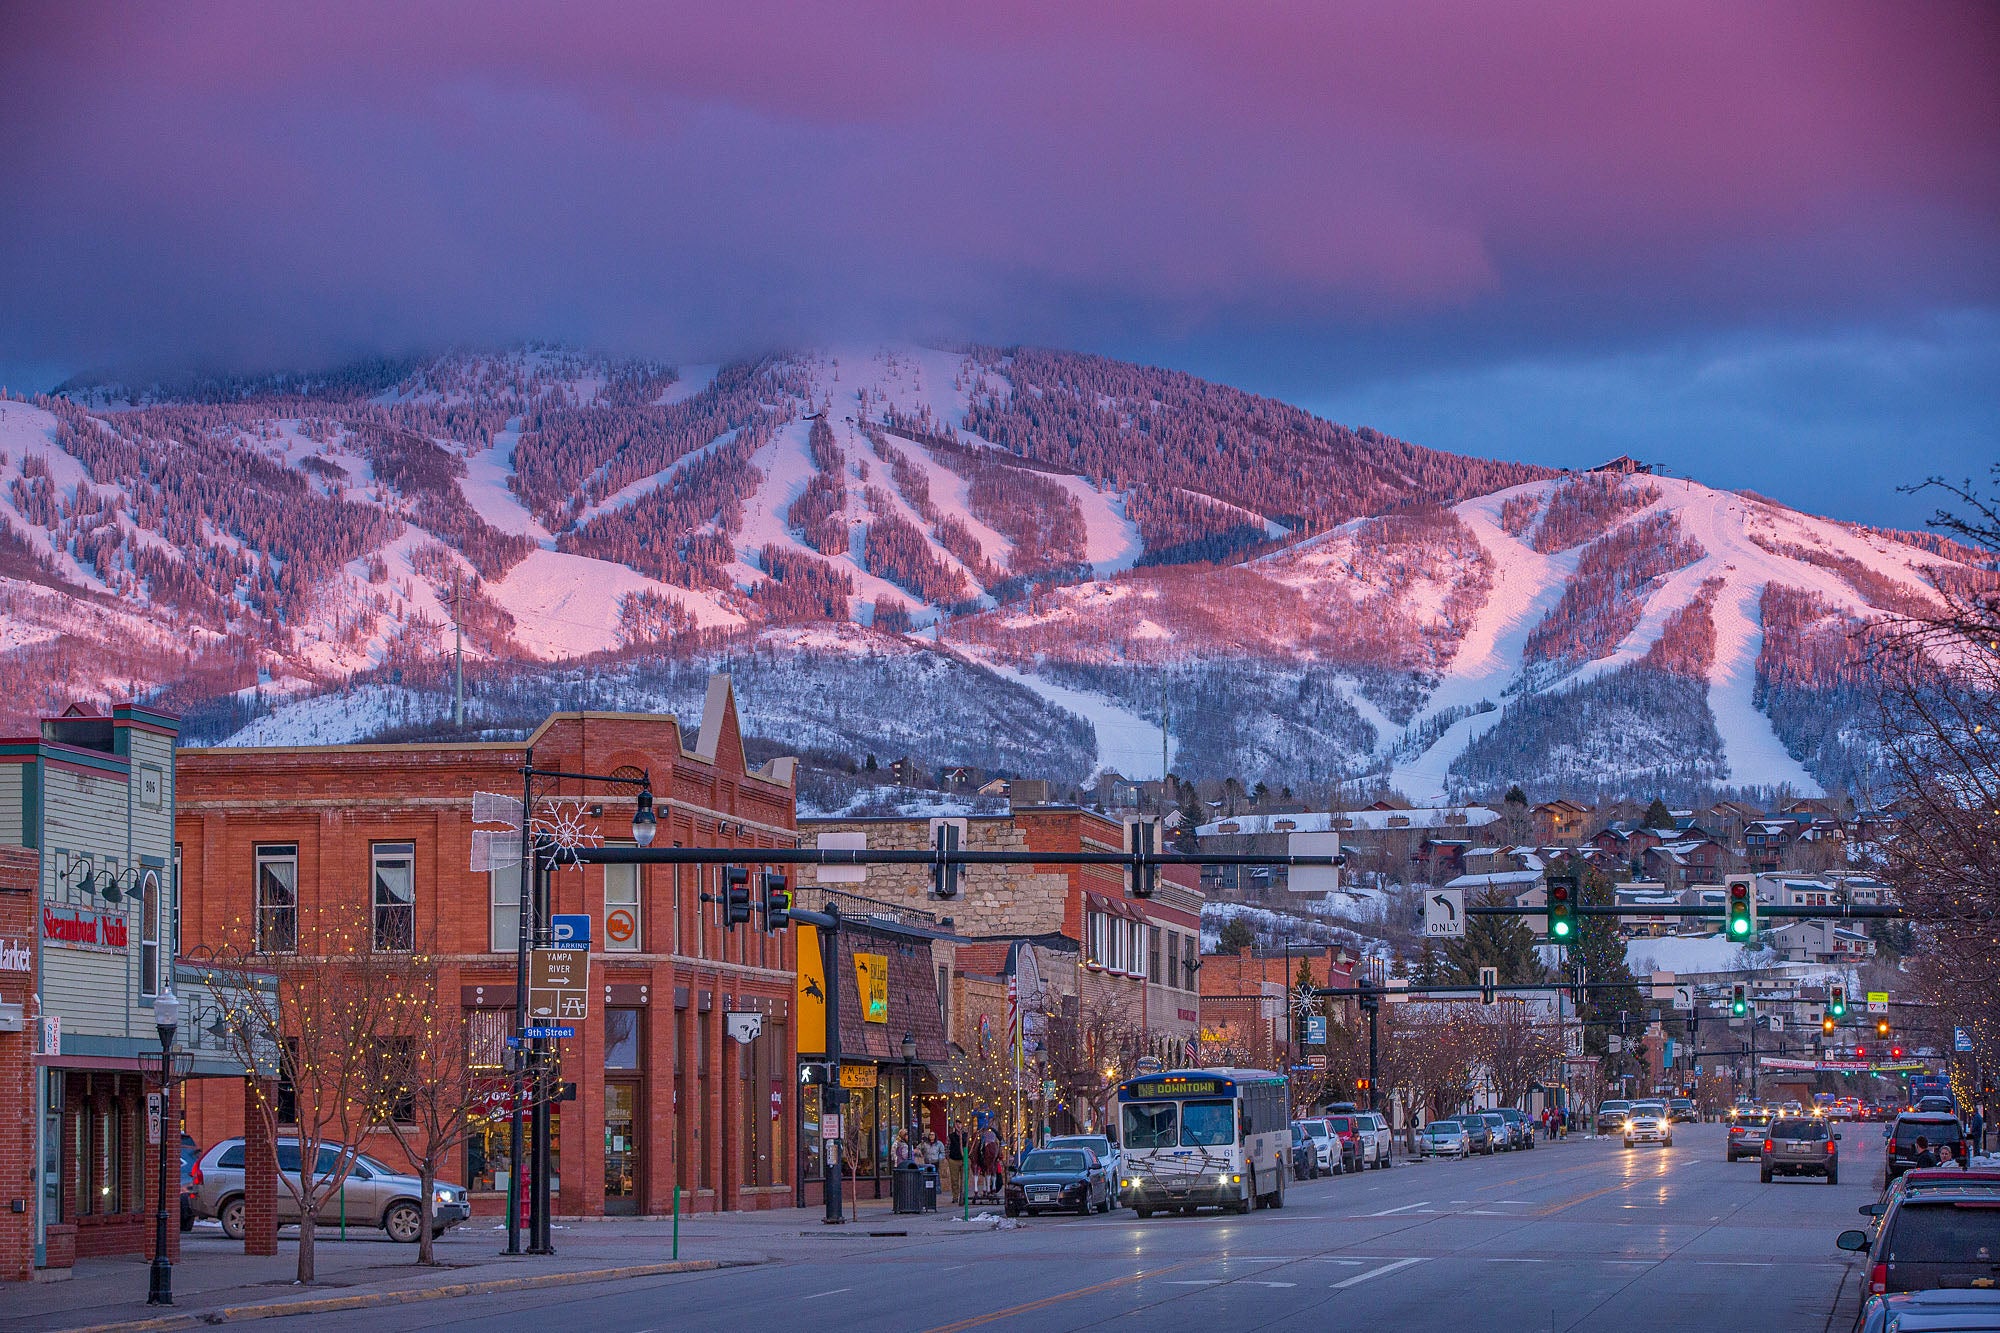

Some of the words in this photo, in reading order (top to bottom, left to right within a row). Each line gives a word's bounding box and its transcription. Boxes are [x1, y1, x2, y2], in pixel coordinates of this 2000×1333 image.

[43, 907, 98, 944] Steamboat
[101, 915, 128, 947] Nails
[1431, 923, 1459, 932] ONLY
[0, 939, 31, 972] arket
[546, 953, 573, 961] YAMPA
[548, 965, 570, 973] RIVER
[527, 1029, 542, 1037] 9th
[545, 1029, 572, 1037] Street
[858, 1067, 876, 1077] Light
[1157, 1082, 1215, 1094] DOWNTOWN
[1223, 1149, 1234, 1157] 61
